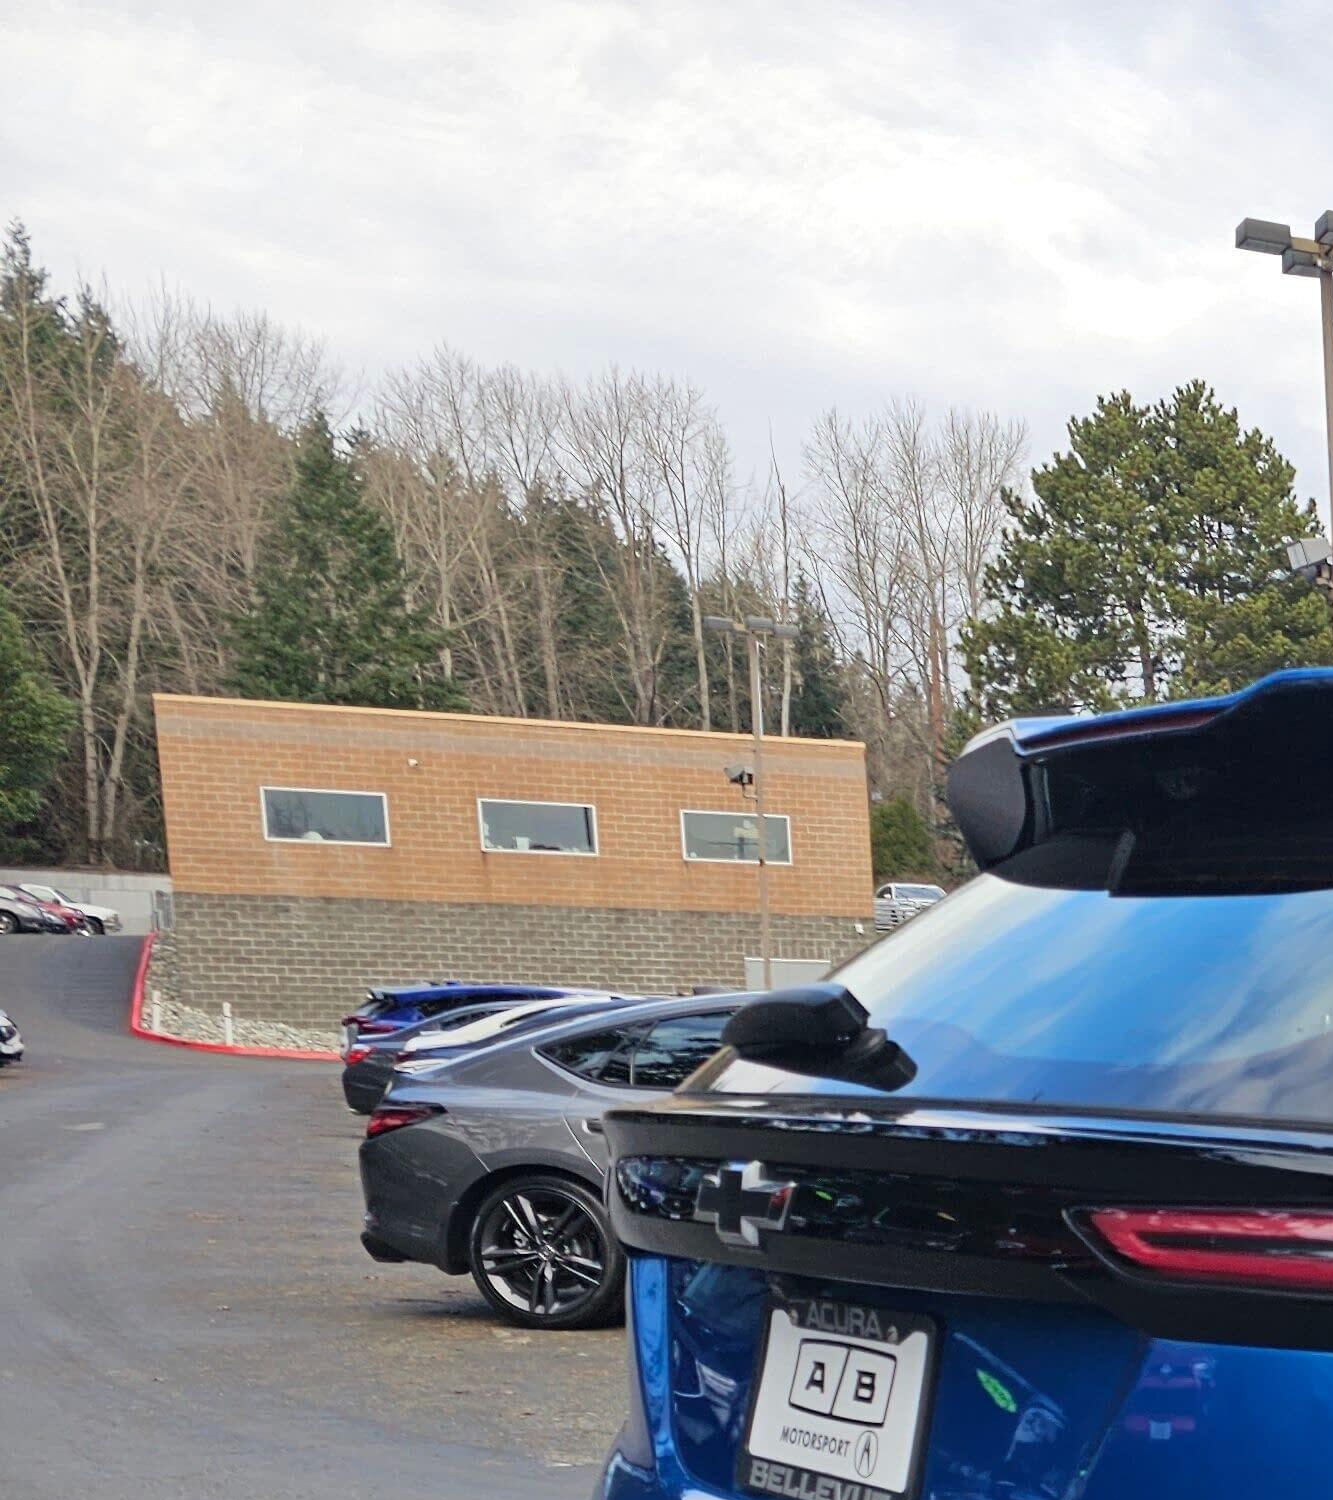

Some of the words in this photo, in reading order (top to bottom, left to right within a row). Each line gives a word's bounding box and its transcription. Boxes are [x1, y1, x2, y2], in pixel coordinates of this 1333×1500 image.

[806, 1302, 884, 1336] ACURA
[805, 1361, 826, 1394] A
[853, 1370, 877, 1403] B
[779, 1425, 851, 1458] MOTORSPORT
